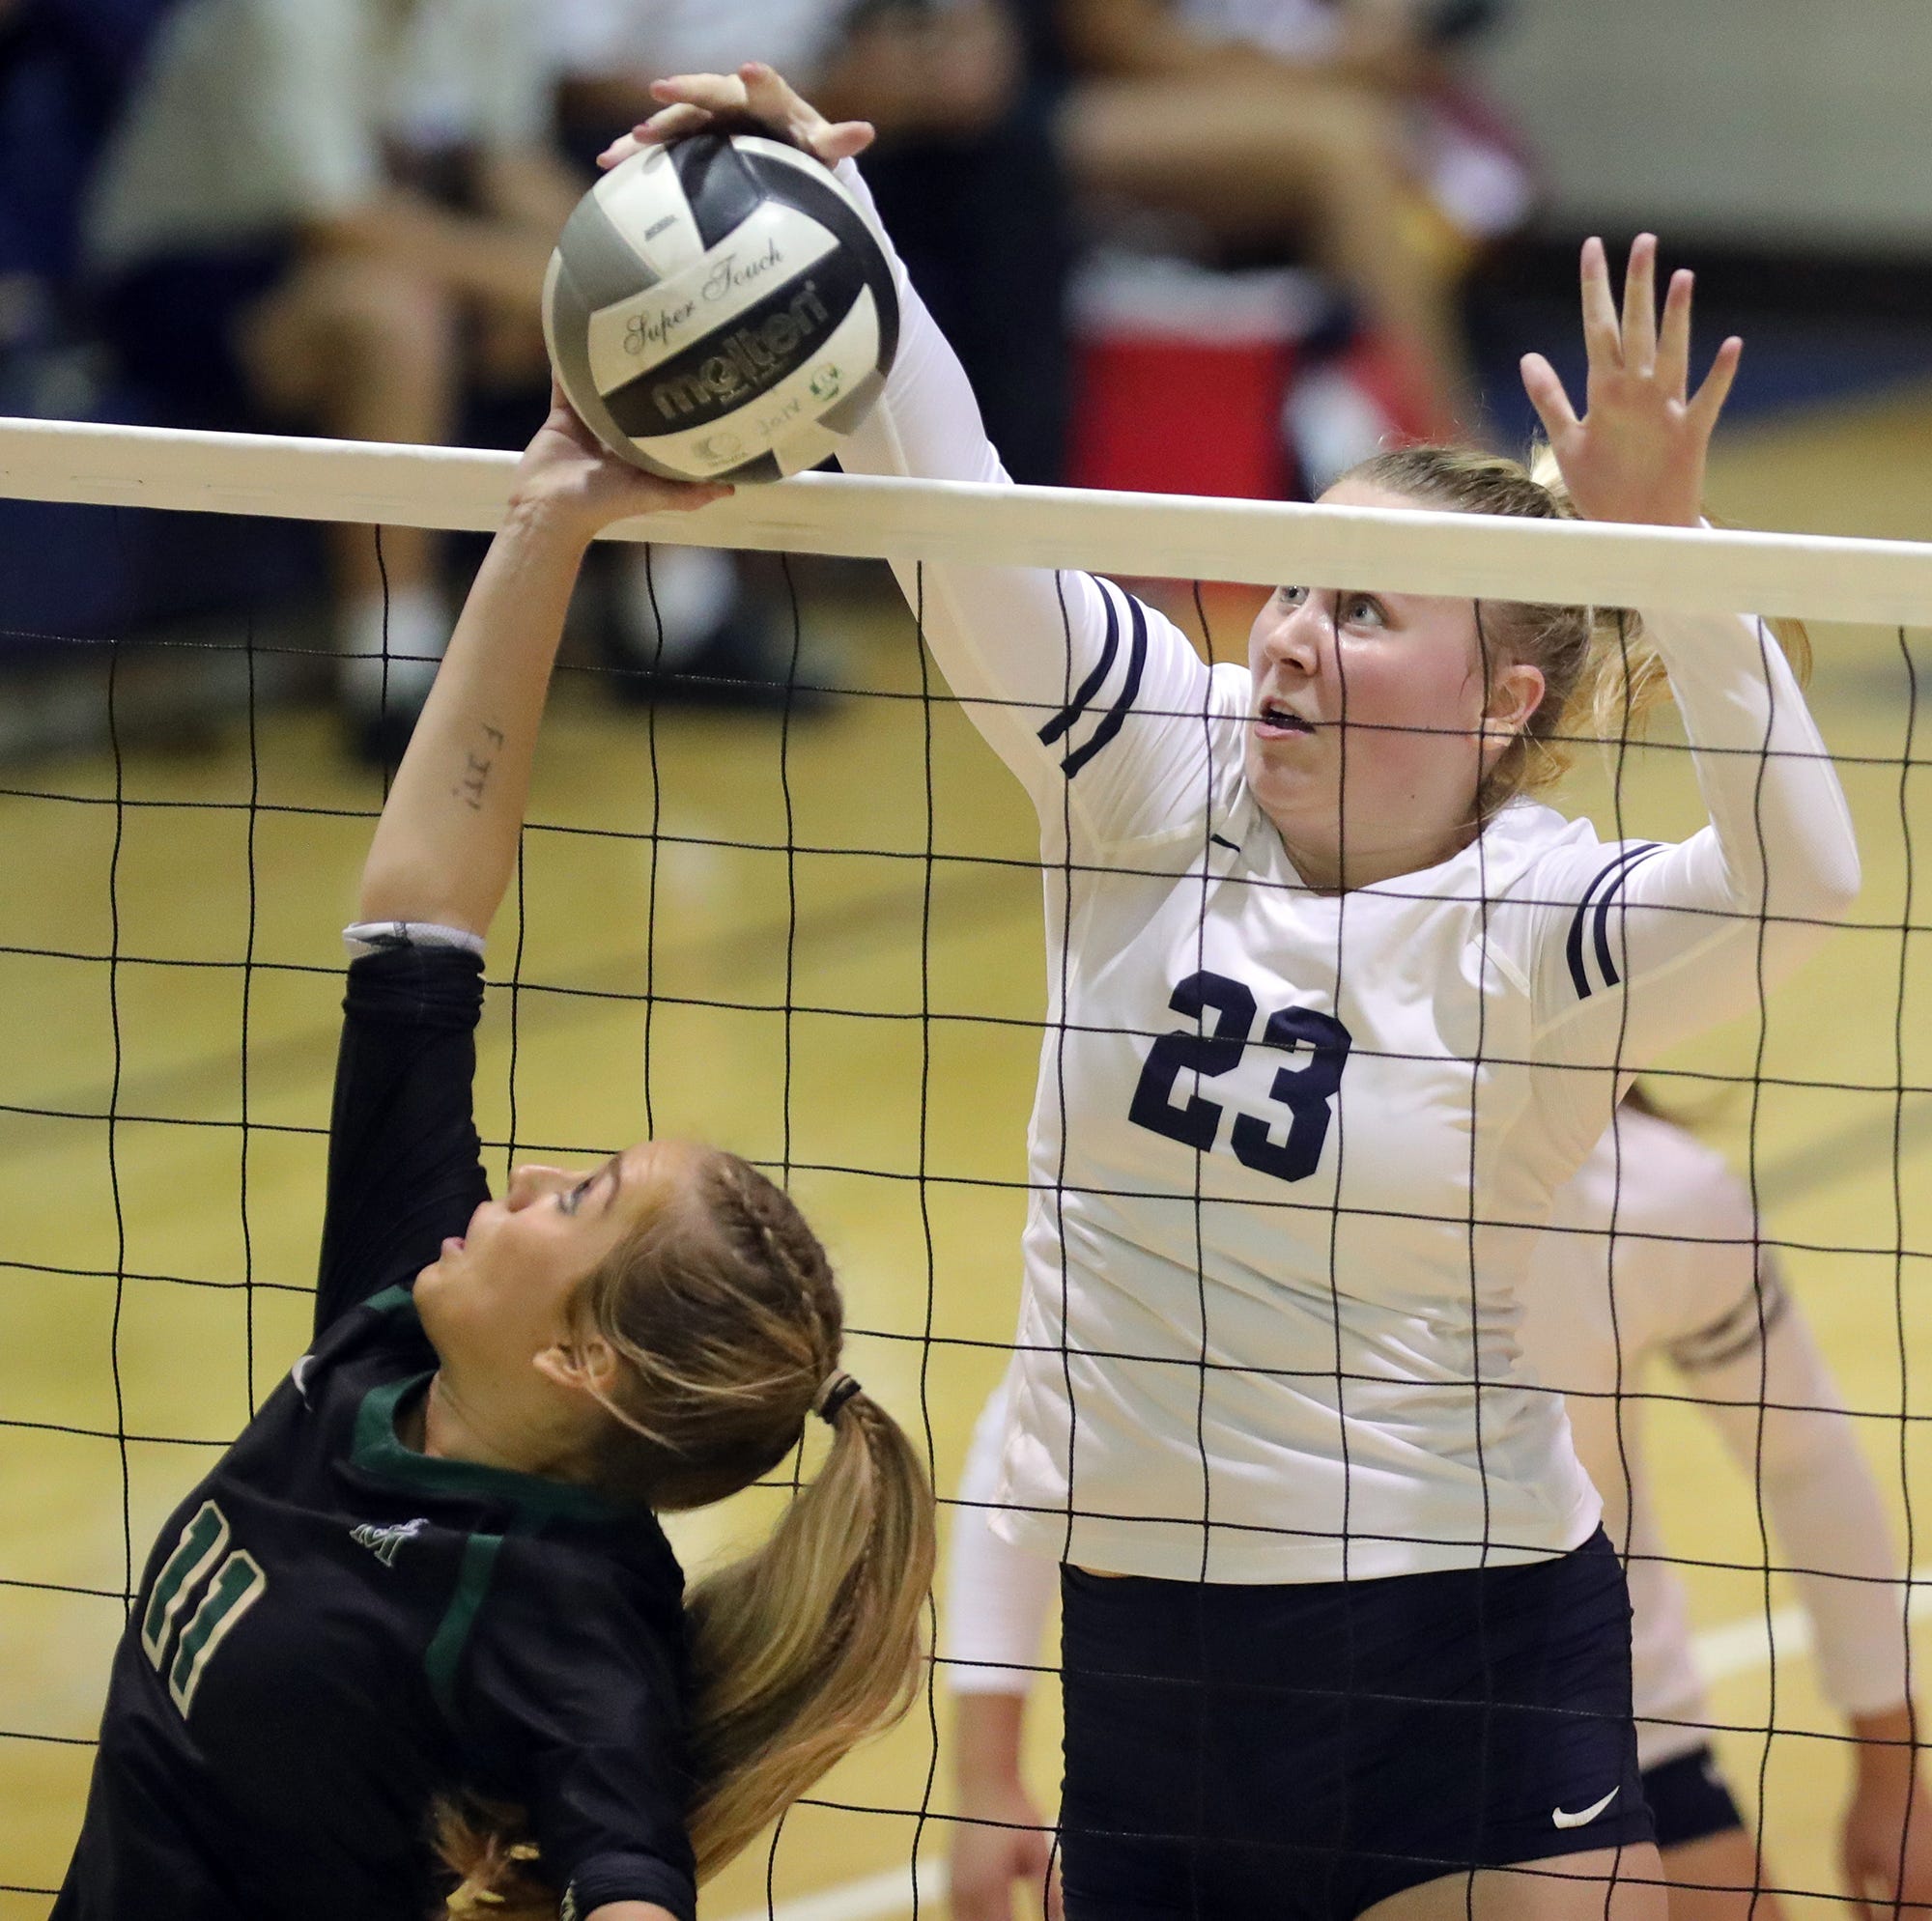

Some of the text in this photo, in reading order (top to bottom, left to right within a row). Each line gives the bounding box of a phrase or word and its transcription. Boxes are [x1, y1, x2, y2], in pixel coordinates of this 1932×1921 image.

[623, 237, 783, 355] Super Touch
[652, 290, 830, 420] molten
[1128, 970, 1351, 1182] 23
[141, 1499, 268, 1721] 11
